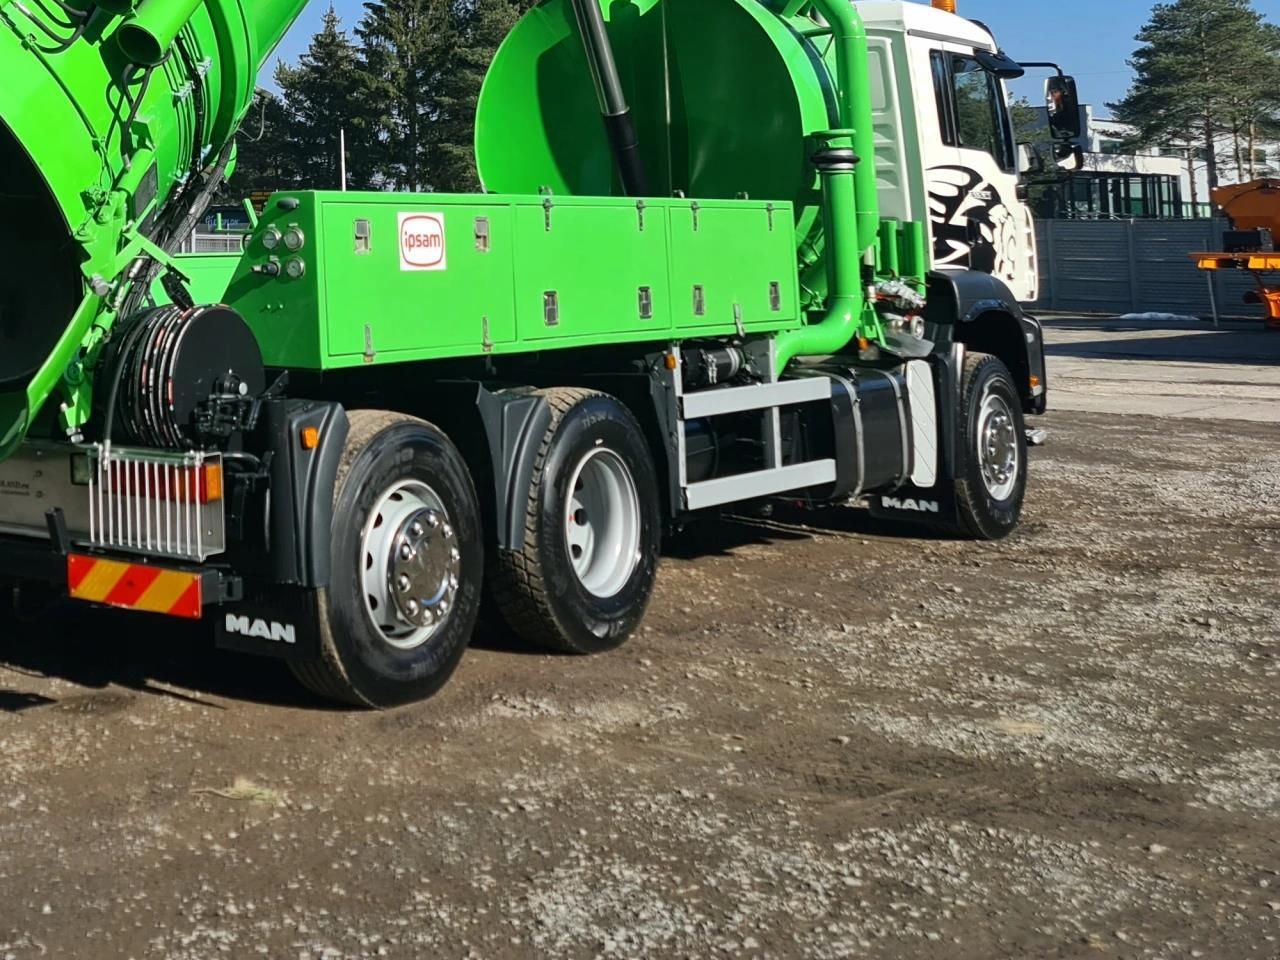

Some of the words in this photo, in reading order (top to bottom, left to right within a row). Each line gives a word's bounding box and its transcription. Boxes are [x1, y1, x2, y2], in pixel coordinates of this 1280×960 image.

[404, 230, 441, 252] ipsam
[881, 496, 939, 512] MAN
[225, 613, 296, 643] MAN
